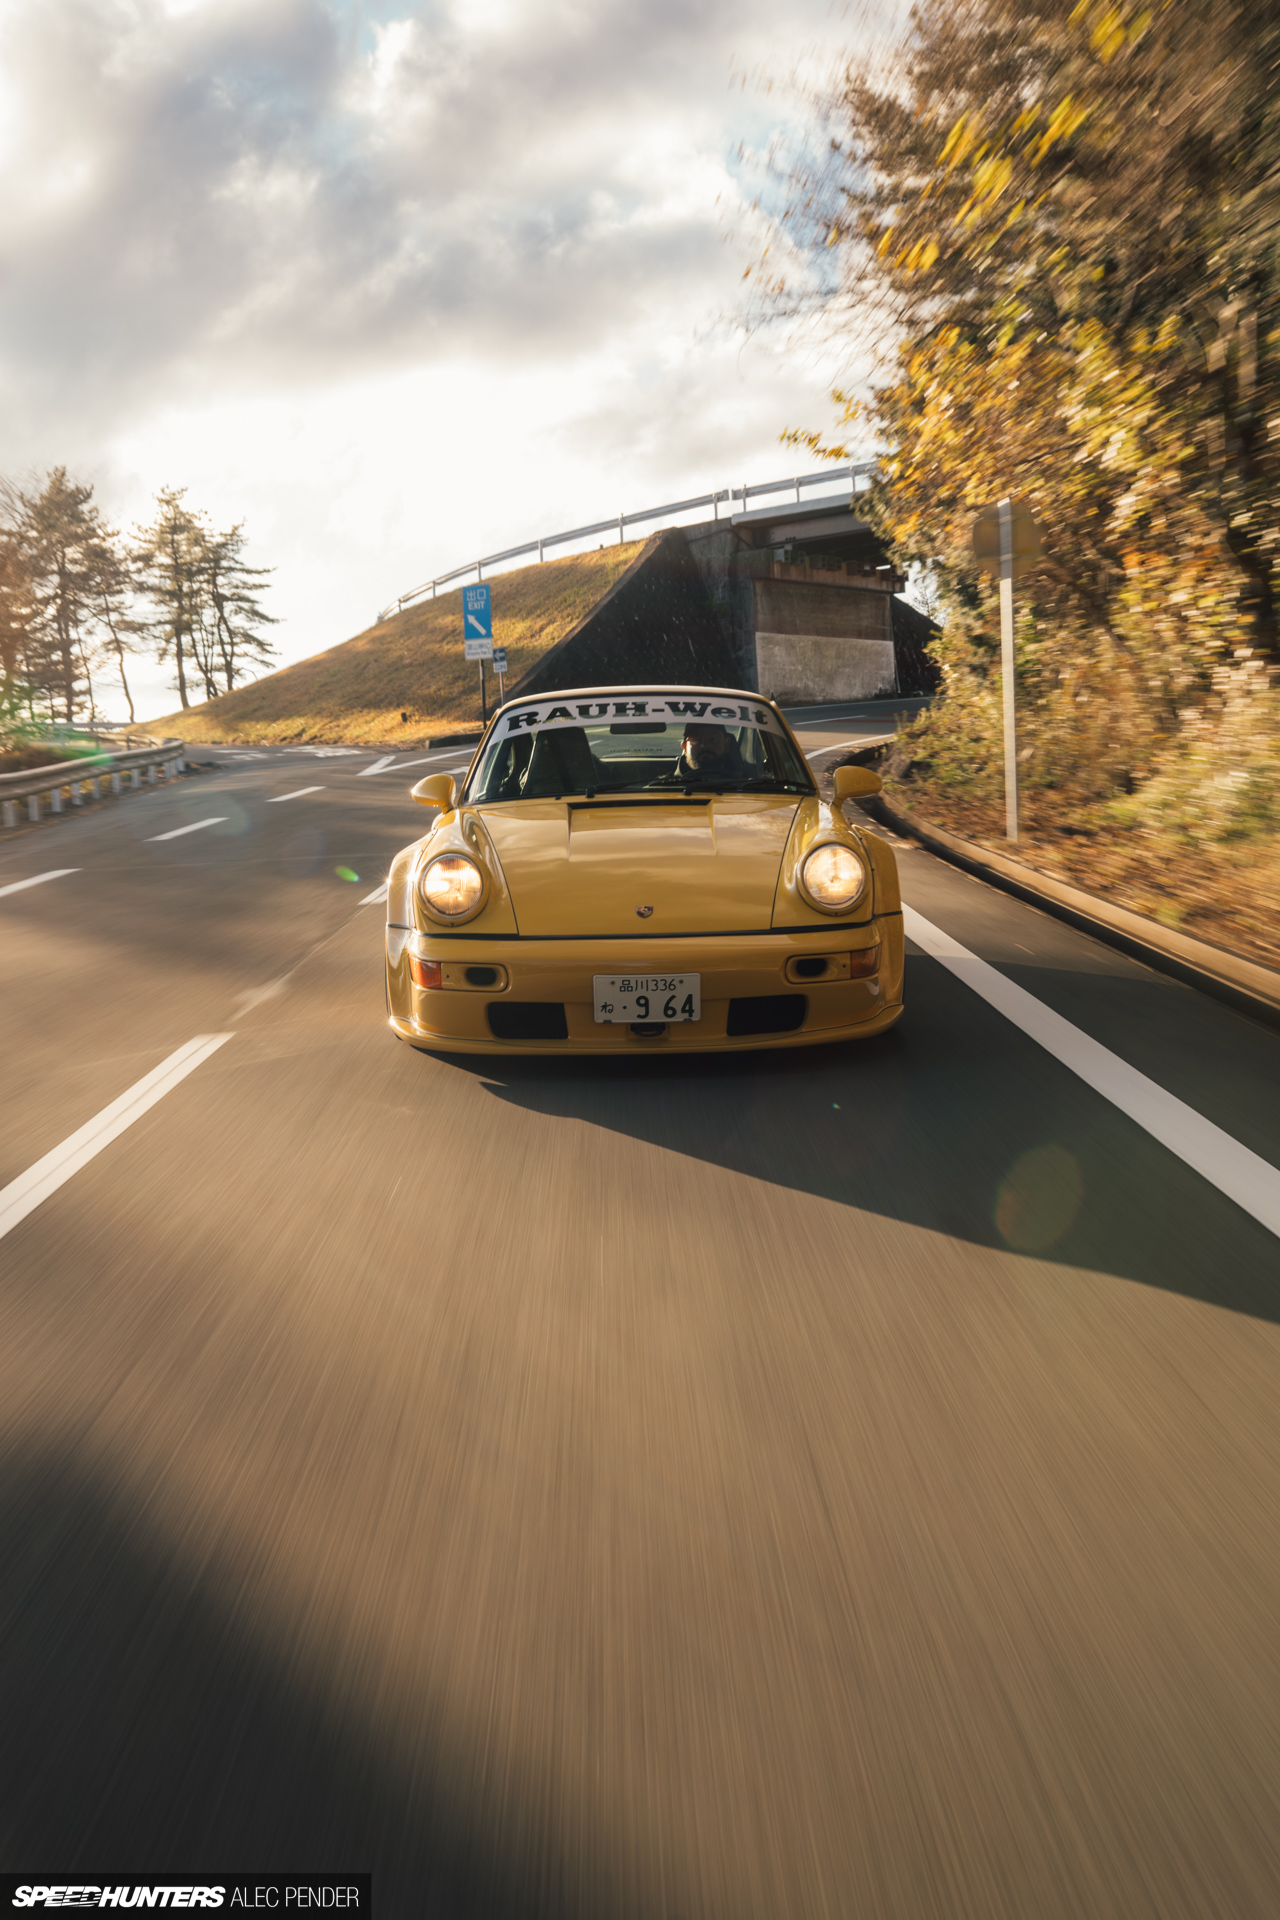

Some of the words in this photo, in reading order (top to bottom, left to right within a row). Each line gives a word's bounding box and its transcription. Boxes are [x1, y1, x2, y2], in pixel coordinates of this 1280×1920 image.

[466, 589, 486, 601] 出口
[468, 600, 485, 610] EXIT
[505, 701, 769, 732] RAUH-Welt
[600, 1001, 614, 1014] ね
